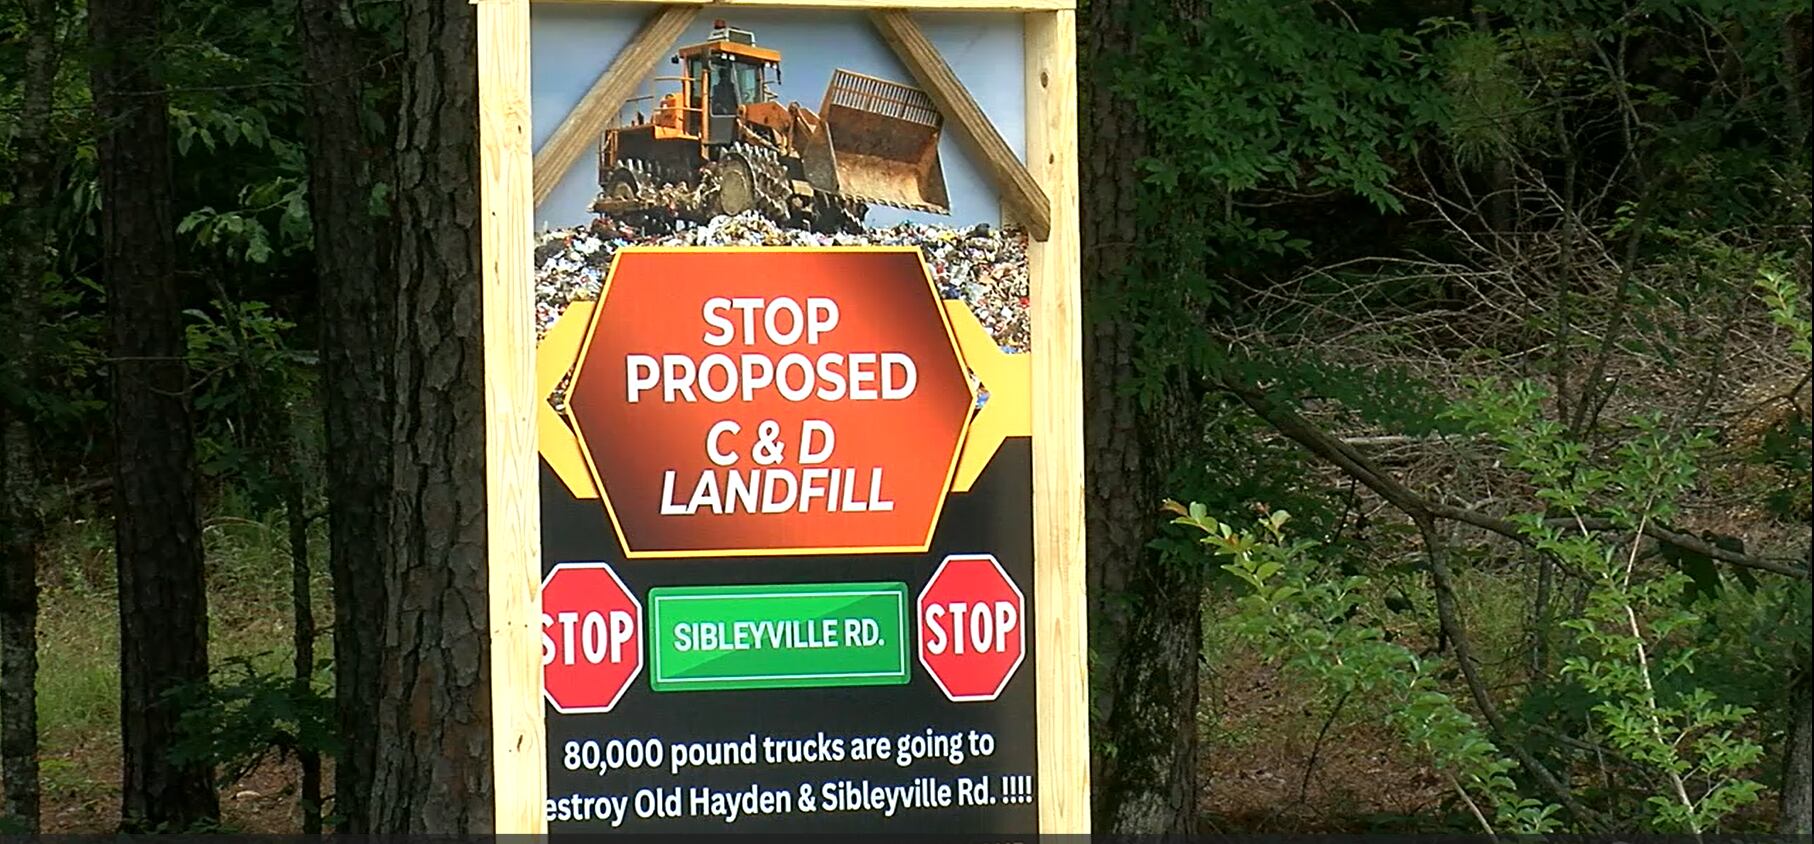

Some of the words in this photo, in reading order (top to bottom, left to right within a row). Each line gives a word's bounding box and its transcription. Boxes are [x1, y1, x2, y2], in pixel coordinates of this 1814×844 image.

[703, 297, 839, 346] STOP
[626, 353, 917, 403] PROPOSED
[707, 420, 739, 465] C
[752, 419, 784, 465] &
[799, 420, 835, 465] D
[660, 467, 894, 516] LANDFILL
[542, 610, 634, 666] STOP
[673, 618, 840, 652] SIBLEYVILLE
[844, 618, 885, 647] RD.
[924, 600, 1017, 655] STOP
[563, 738, 664, 776] 80,000
[670, 734, 757, 774] pound
[762, 731, 845, 764] trucks
[850, 735, 891, 761] are
[896, 728, 964, 767] going
[968, 729, 995, 756] to
[545, 793, 629, 828] estroy
[634, 786, 683, 819] Old
[689, 784, 792, 823] Hayden
[797, 783, 817, 813] &
[821, 777, 952, 818] Sibleyville
[957, 775, 997, 807] Rd.
[1002, 775, 1033, 804] !!!!
